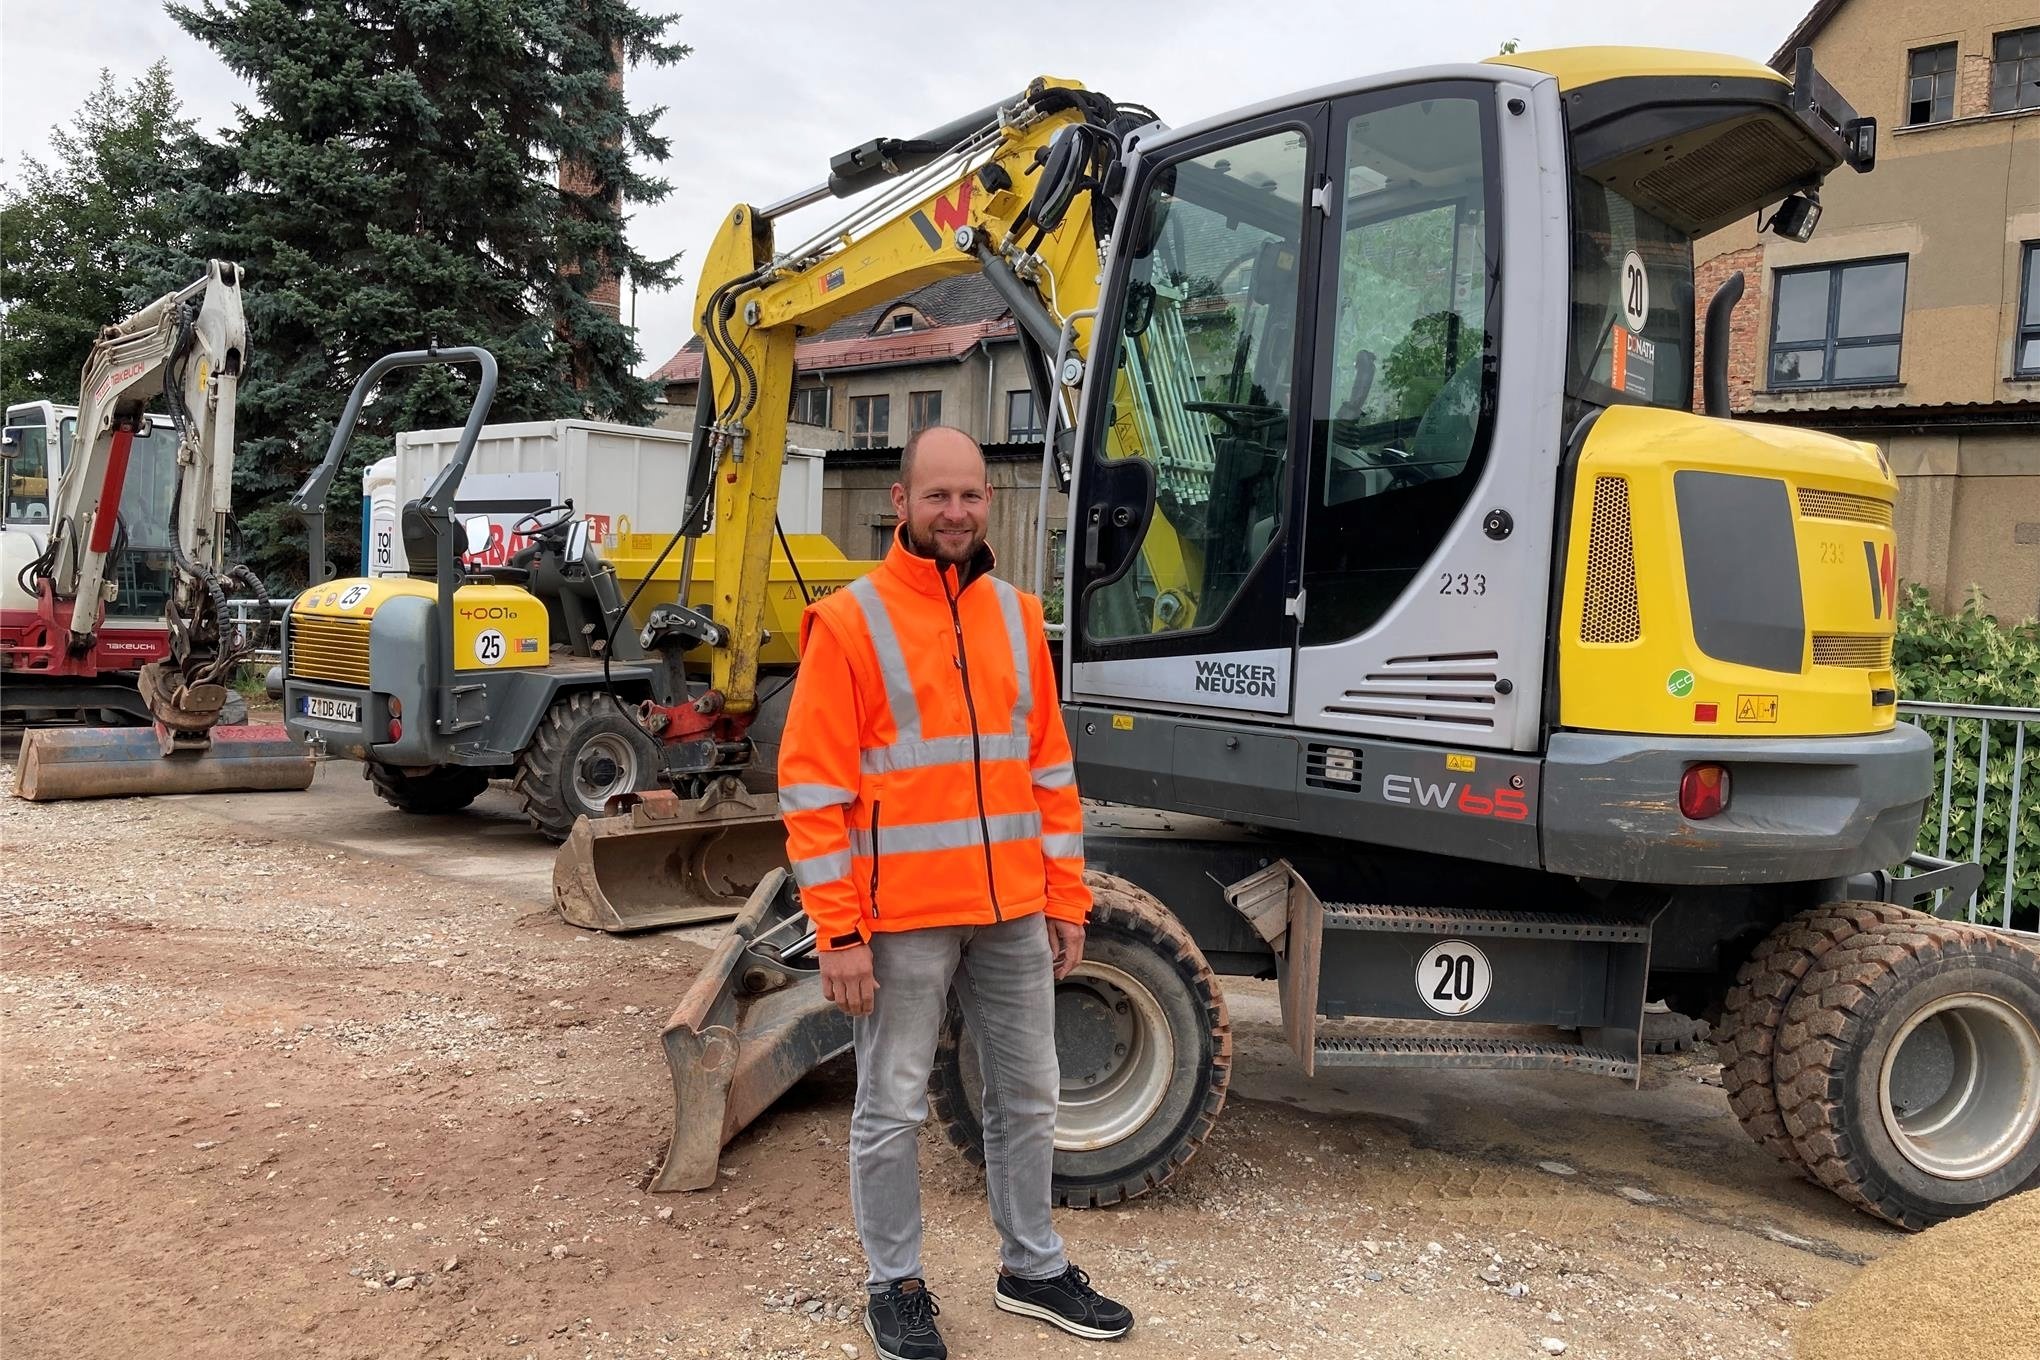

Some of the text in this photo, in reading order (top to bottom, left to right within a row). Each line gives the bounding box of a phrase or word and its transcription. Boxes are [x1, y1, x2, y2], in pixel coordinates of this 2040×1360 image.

[1627, 264, 1642, 318] 20
[1627, 334, 1655, 360] DONATH
[341, 586, 368, 605] 25
[1440, 573, 1486, 596] 233
[481, 635, 500, 659] 25
[1195, 660, 1276, 682] WACKER
[1195, 676, 1276, 698] NEUSON
[1667, 672, 1695, 695] ECO
[311, 699, 354, 719] Z DB 404
[1433, 954, 1475, 1001] 20
